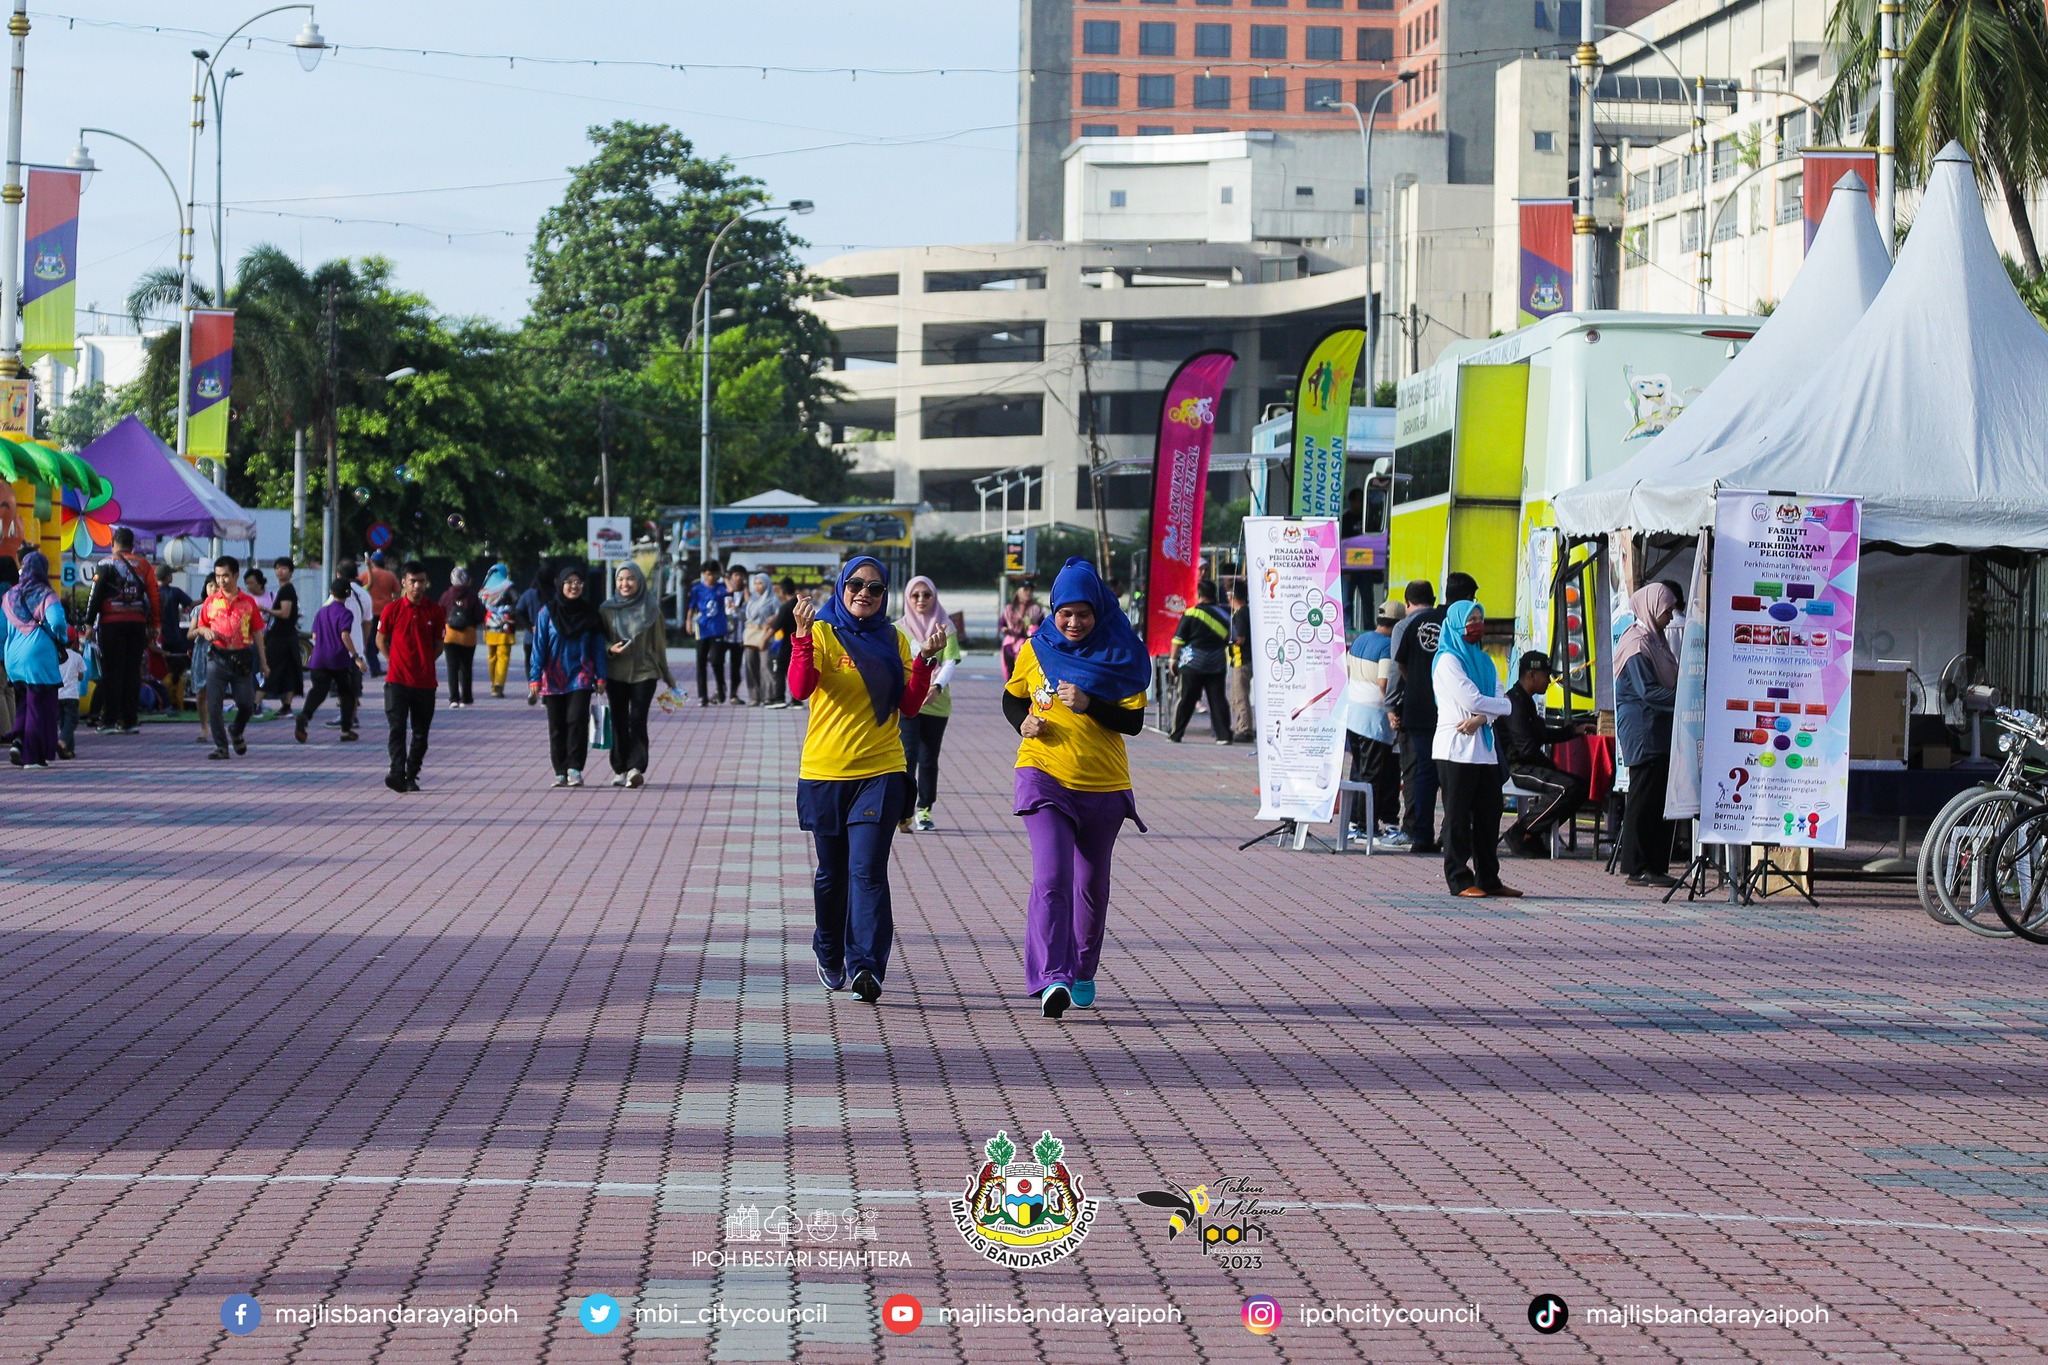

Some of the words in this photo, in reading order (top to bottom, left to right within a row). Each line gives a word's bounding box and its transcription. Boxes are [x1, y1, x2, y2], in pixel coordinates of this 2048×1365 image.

[1184, 445, 1200, 501] FIZIKAL
[1302, 435, 1315, 514] LAKUKAN
[1169, 449, 1187, 523] LAKUKAN
[1180, 502, 1193, 567] AKTIVITI
[1767, 526, 1808, 536] FASILITI
[1777, 535, 1798, 543] DAN
[1748, 541, 1825, 552] PERKHIDMATAN
[1305, 554, 1320, 562] DAN
[1759, 550, 1813, 559] PERGIGIAN
[1744, 560, 1790, 570] Perkhidmatan
[1791, 562, 1821, 573] Pergigian
[1822, 564, 1829, 572] di
[1761, 571, 1779, 579] Klinik
[1780, 572, 1810, 582] Pergigian
[1748, 668, 1777, 677] Rawatan
[1778, 669, 1812, 679] Kepakaran
[1755, 678, 1774, 686] Klinik
[1774, 679, 1804, 688] Pergigian
[1766, 777, 1797, 785] membantu
[1797, 778, 1827, 786] tingkatkan
[1768, 793, 1792, 801] Malaysia
[1715, 802, 1753, 811] Semuanya
[1714, 812, 1745, 821] Bermula
